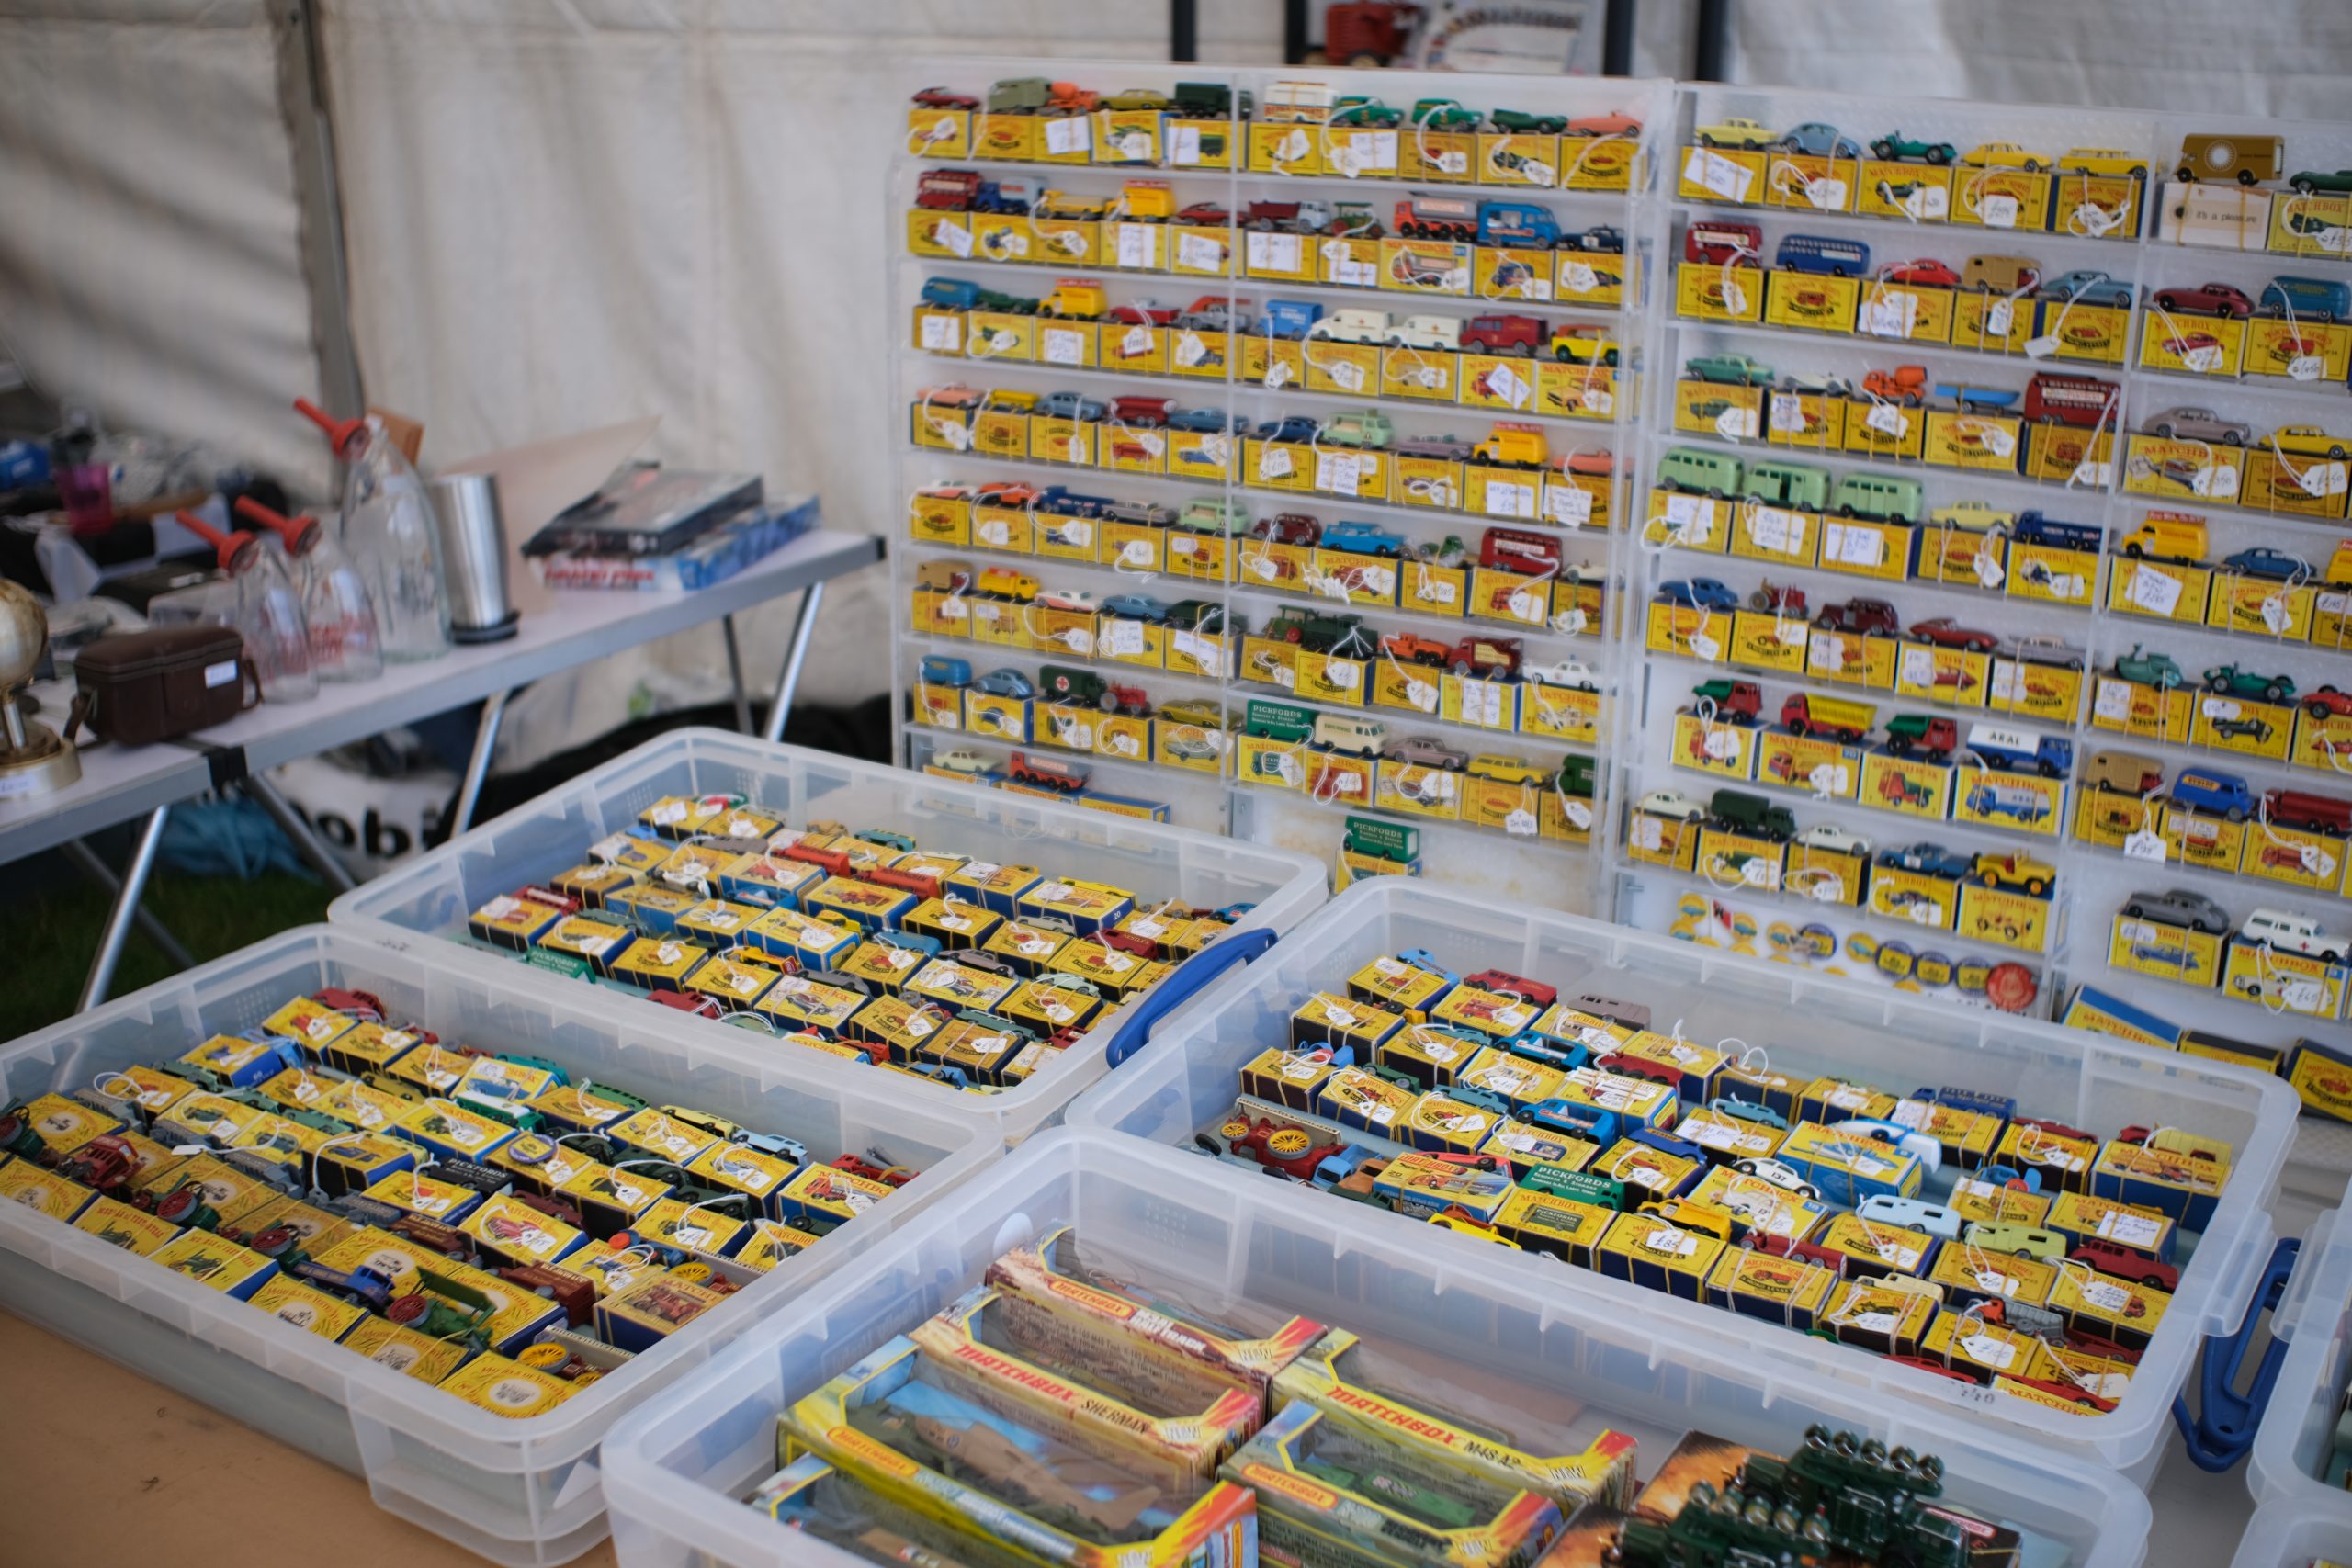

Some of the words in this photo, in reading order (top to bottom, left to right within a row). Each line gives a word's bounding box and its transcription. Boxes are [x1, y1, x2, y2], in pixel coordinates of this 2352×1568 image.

[1253, 705, 1302, 718] PICKFORDS
[1987, 731, 2020, 746] ARAL
[1353, 821, 1402, 839] PICKFORDS
[447, 1158, 508, 1178] PICKFORDS
[1771, 1169, 1788, 1180] 137
[1539, 1167, 1611, 1189] PICKFORDS
[1521, 1193, 1579, 1212] MATCHBOX
[1536, 1208, 1577, 1223] PICKFORDS
[954, 1344, 1075, 1402] MATCHBOX
[1080, 1398, 1149, 1434] SHERMAN
[2008, 1388, 2090, 1417] MATCHBO
[1325, 1385, 1457, 1447] MATCHBOX
